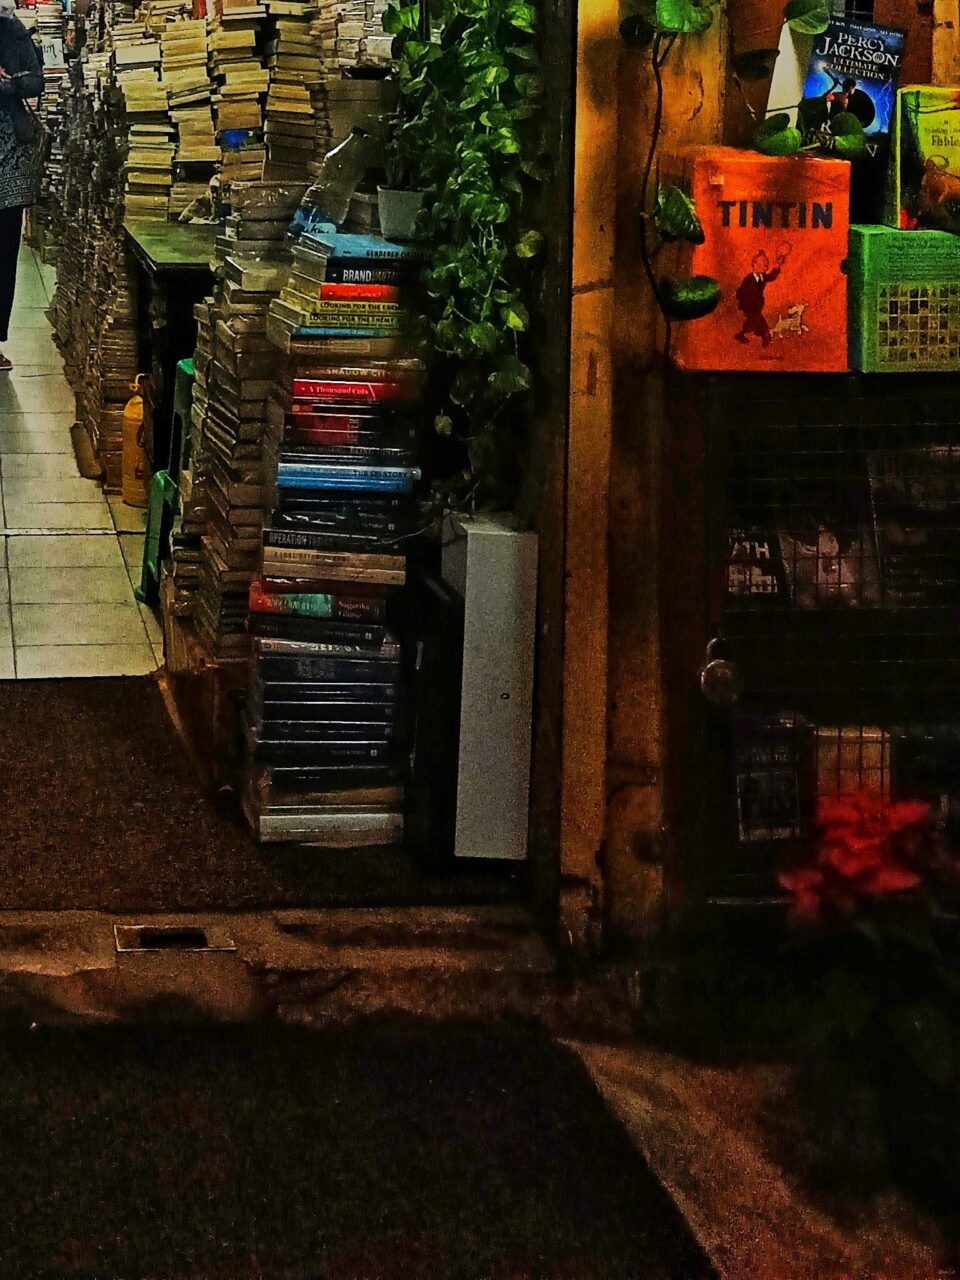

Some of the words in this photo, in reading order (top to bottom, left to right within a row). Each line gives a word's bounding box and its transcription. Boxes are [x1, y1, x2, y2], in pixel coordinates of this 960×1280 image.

[837, 32, 885, 51] PERCY
[815, 36, 900, 67] JACKSON
[832, 57, 879, 71] ULTIMATE
[717, 200, 833, 229] TINTIN
[316, 386, 352, 395] Thousand
